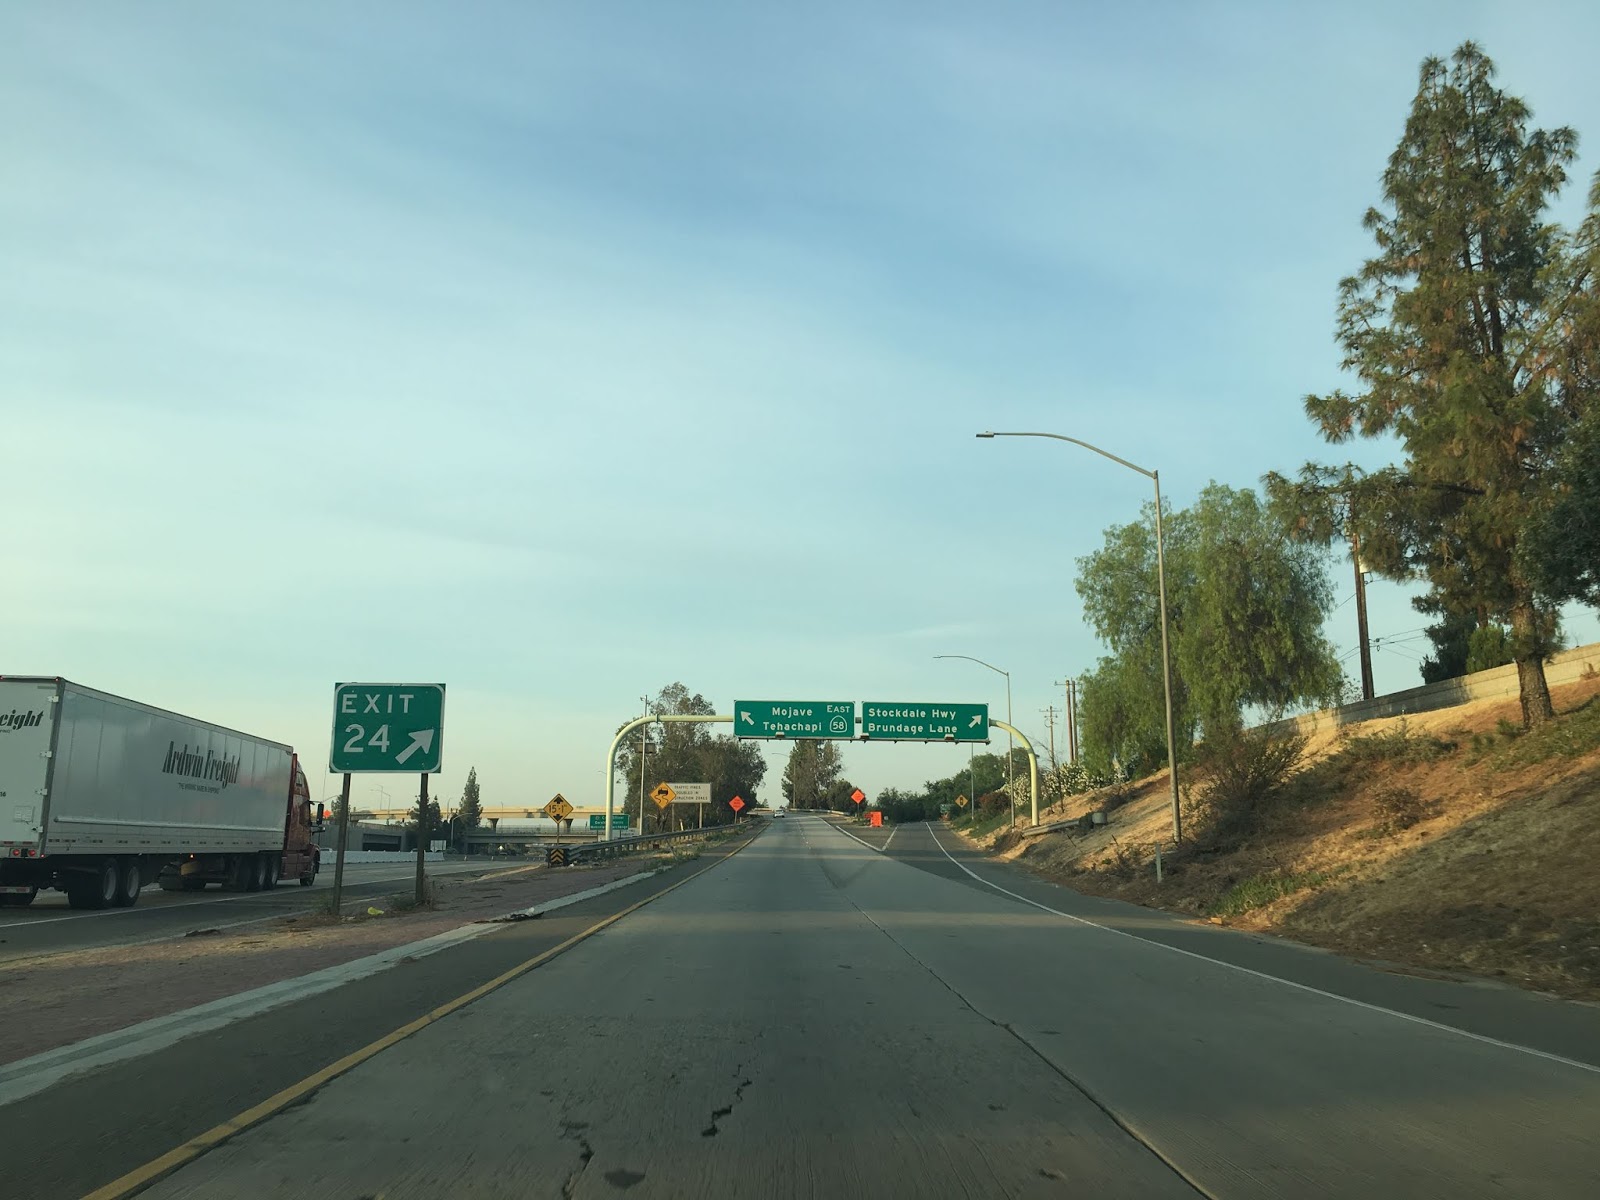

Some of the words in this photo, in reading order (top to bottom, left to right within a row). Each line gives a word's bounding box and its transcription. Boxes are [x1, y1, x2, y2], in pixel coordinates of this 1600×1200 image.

[341, 694, 414, 713] EXIT
[826, 705, 850, 713] EAST
[772, 707, 813, 718] Mojave
[868, 708, 926, 718] Stockdale
[932, 709, 956, 720] Hwy
[763, 722, 822, 733] Tehachapi
[832, 722, 845, 730] 58
[868, 723, 923, 734] Brundage
[929, 724, 958, 733] Lane
[343, 723, 390, 753] 24
[162, 740, 204, 778] Ardwin
[203, 749, 241, 789] Freight
